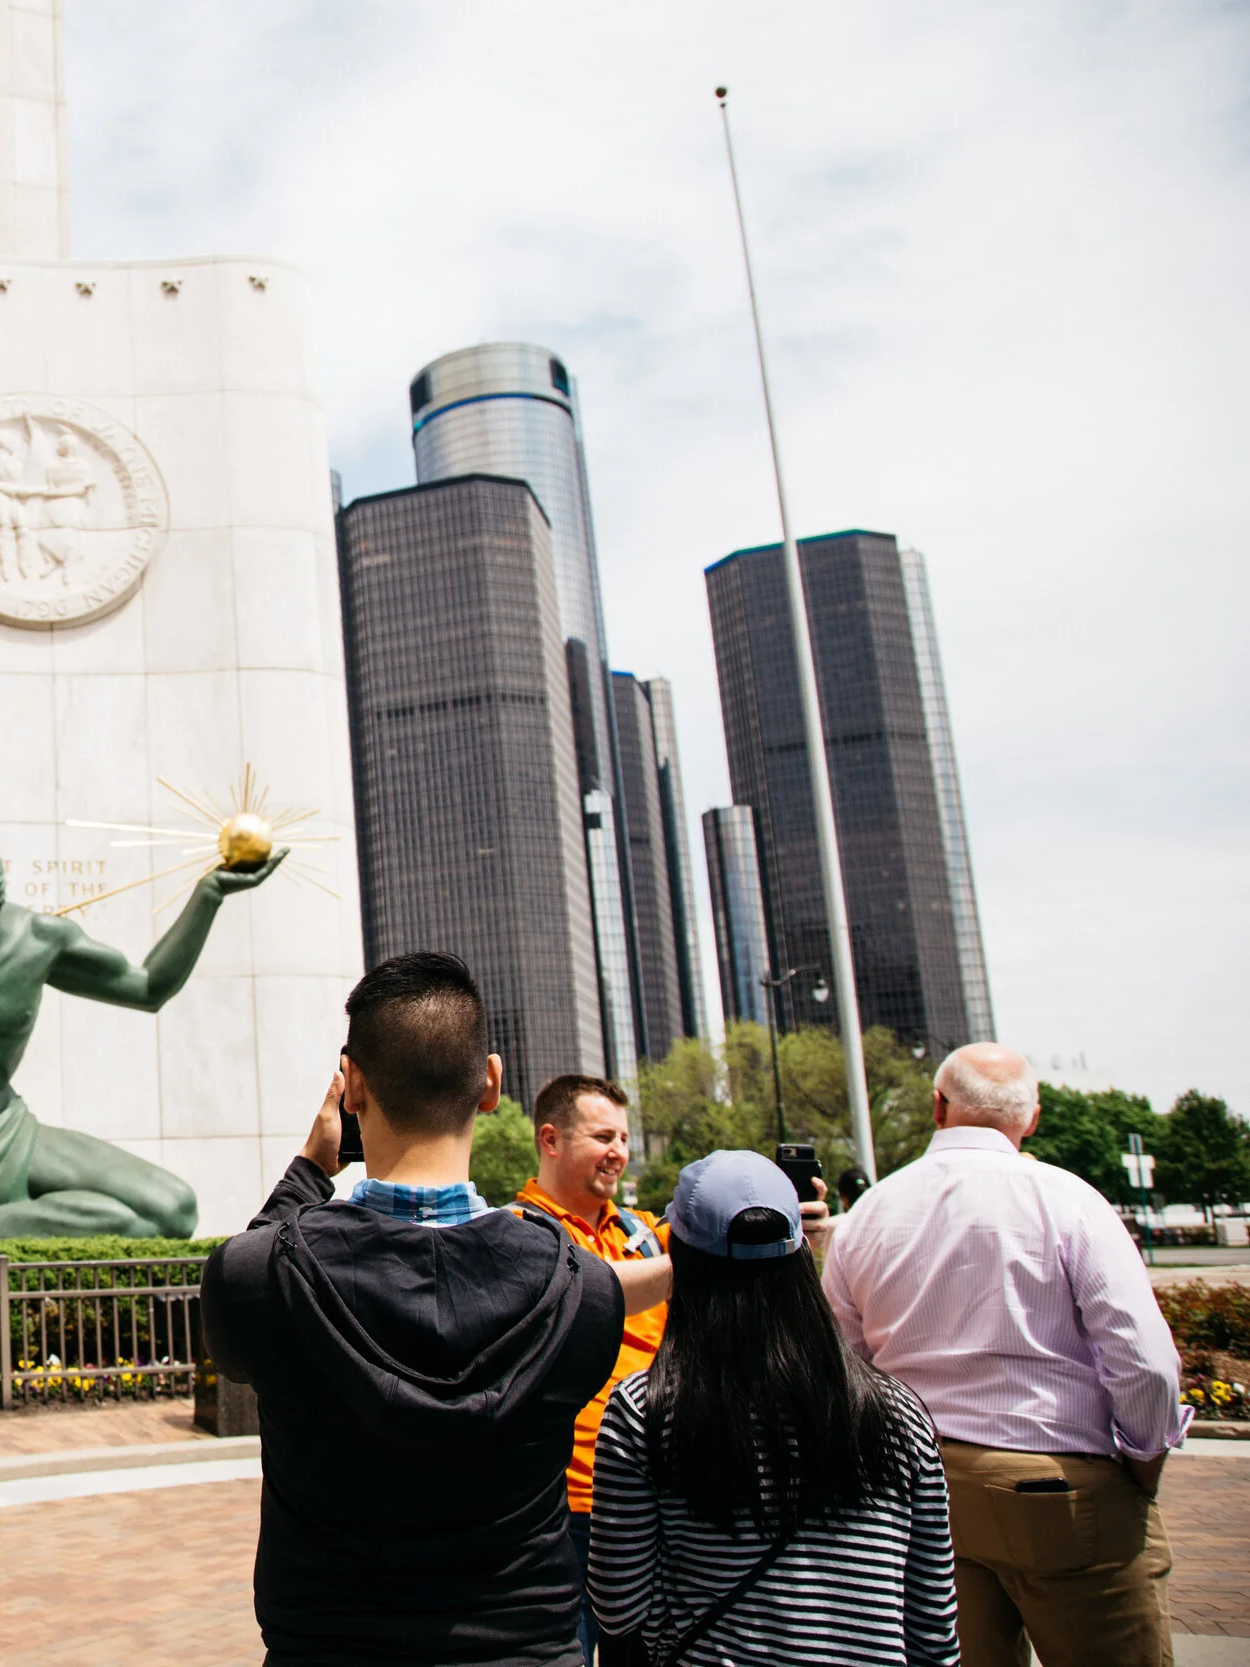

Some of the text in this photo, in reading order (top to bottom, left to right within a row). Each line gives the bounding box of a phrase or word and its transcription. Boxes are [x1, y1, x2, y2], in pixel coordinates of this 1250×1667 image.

[32, 860, 107, 874] SPIRIT
[24, 883, 108, 897] OF THE
